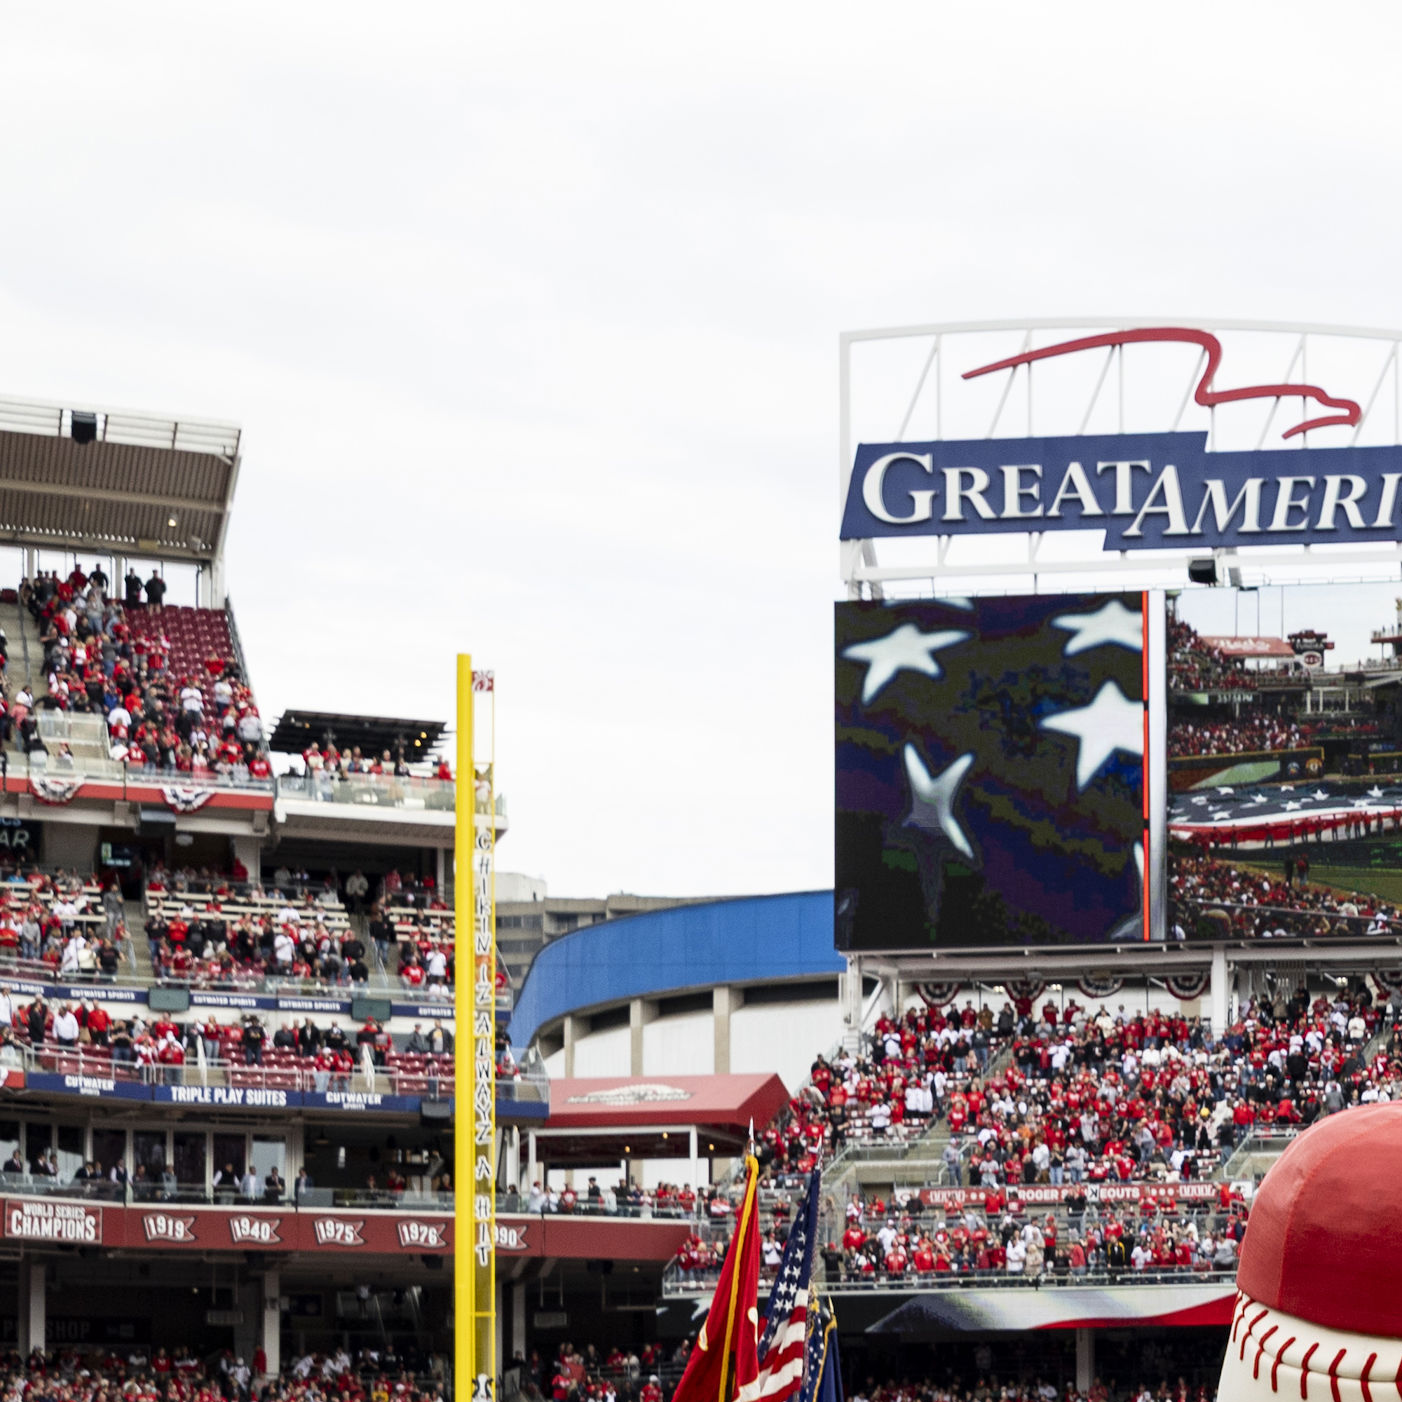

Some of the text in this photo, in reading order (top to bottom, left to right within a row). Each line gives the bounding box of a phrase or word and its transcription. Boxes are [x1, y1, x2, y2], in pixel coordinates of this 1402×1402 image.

[862, 451, 1152, 525] GREAT
[65, 1074, 115, 1092] CUTWATER
[171, 1086, 286, 1107] TRIPLE PLAY SUITES
[325, 1091, 381, 1105] CUTWATER
[22, 1202, 86, 1220] WORLD SERIES
[11, 1209, 96, 1241] CHAMPIONS
[148, 1215, 185, 1239] 1919
[234, 1216, 270, 1241] 1940
[317, 1219, 354, 1242] 1975
[402, 1222, 438, 1245] 1976
